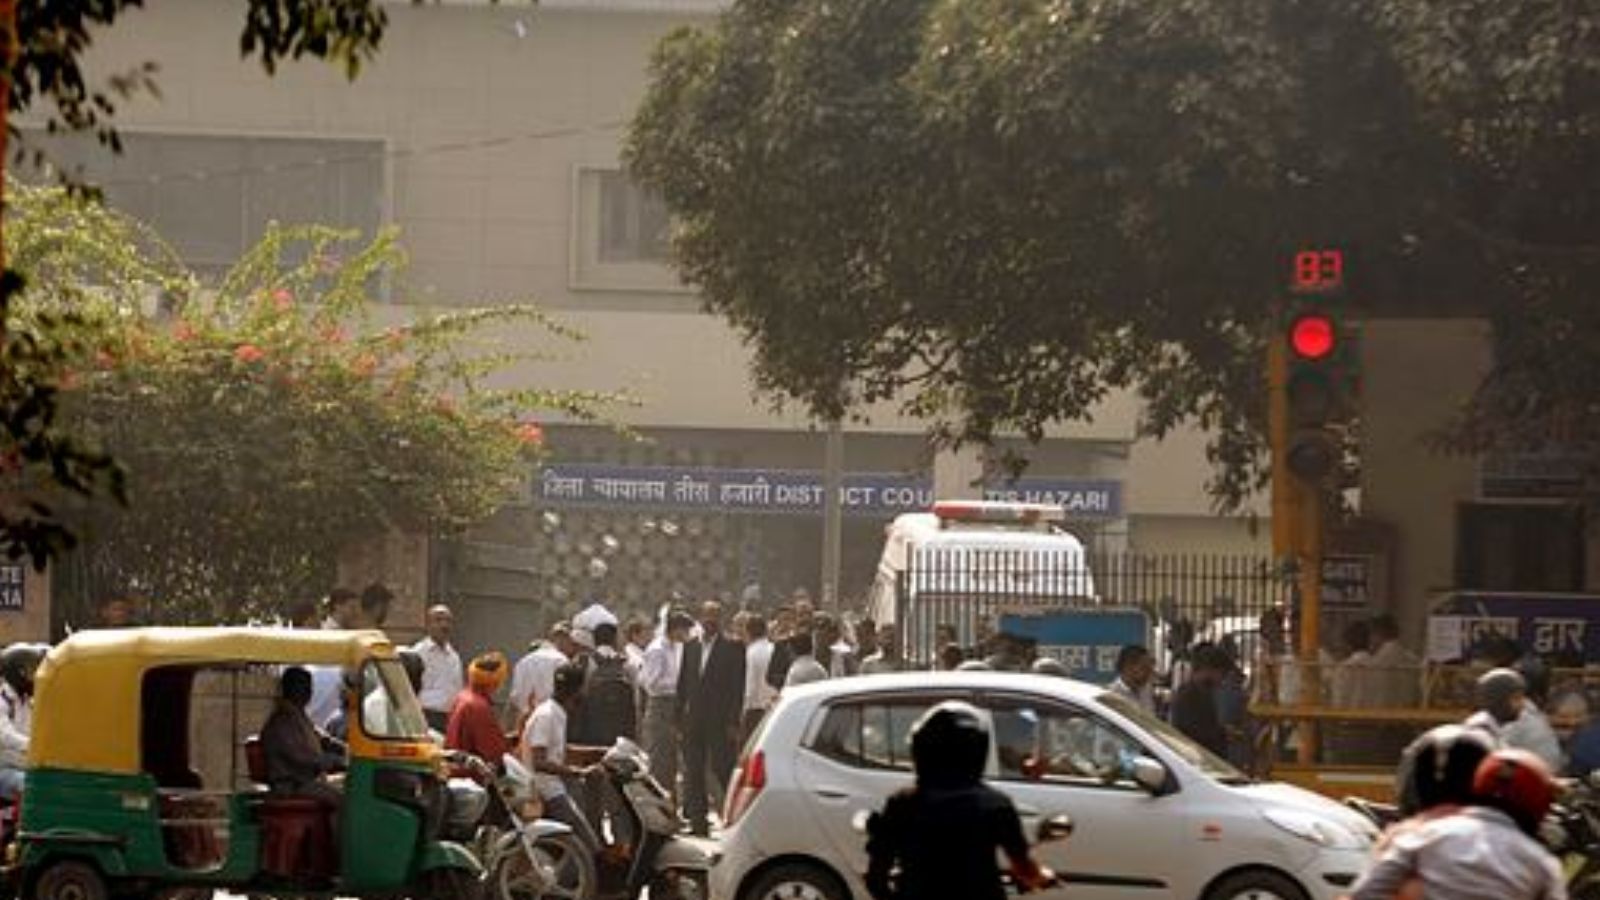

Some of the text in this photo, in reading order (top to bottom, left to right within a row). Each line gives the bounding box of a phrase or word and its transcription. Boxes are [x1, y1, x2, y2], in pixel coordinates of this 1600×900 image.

[1295, 250, 1343, 286] 83
[777, 484, 876, 505] DISTICT
[881, 487, 933, 505] COU
[1025, 489, 1109, 511] HAZARI
